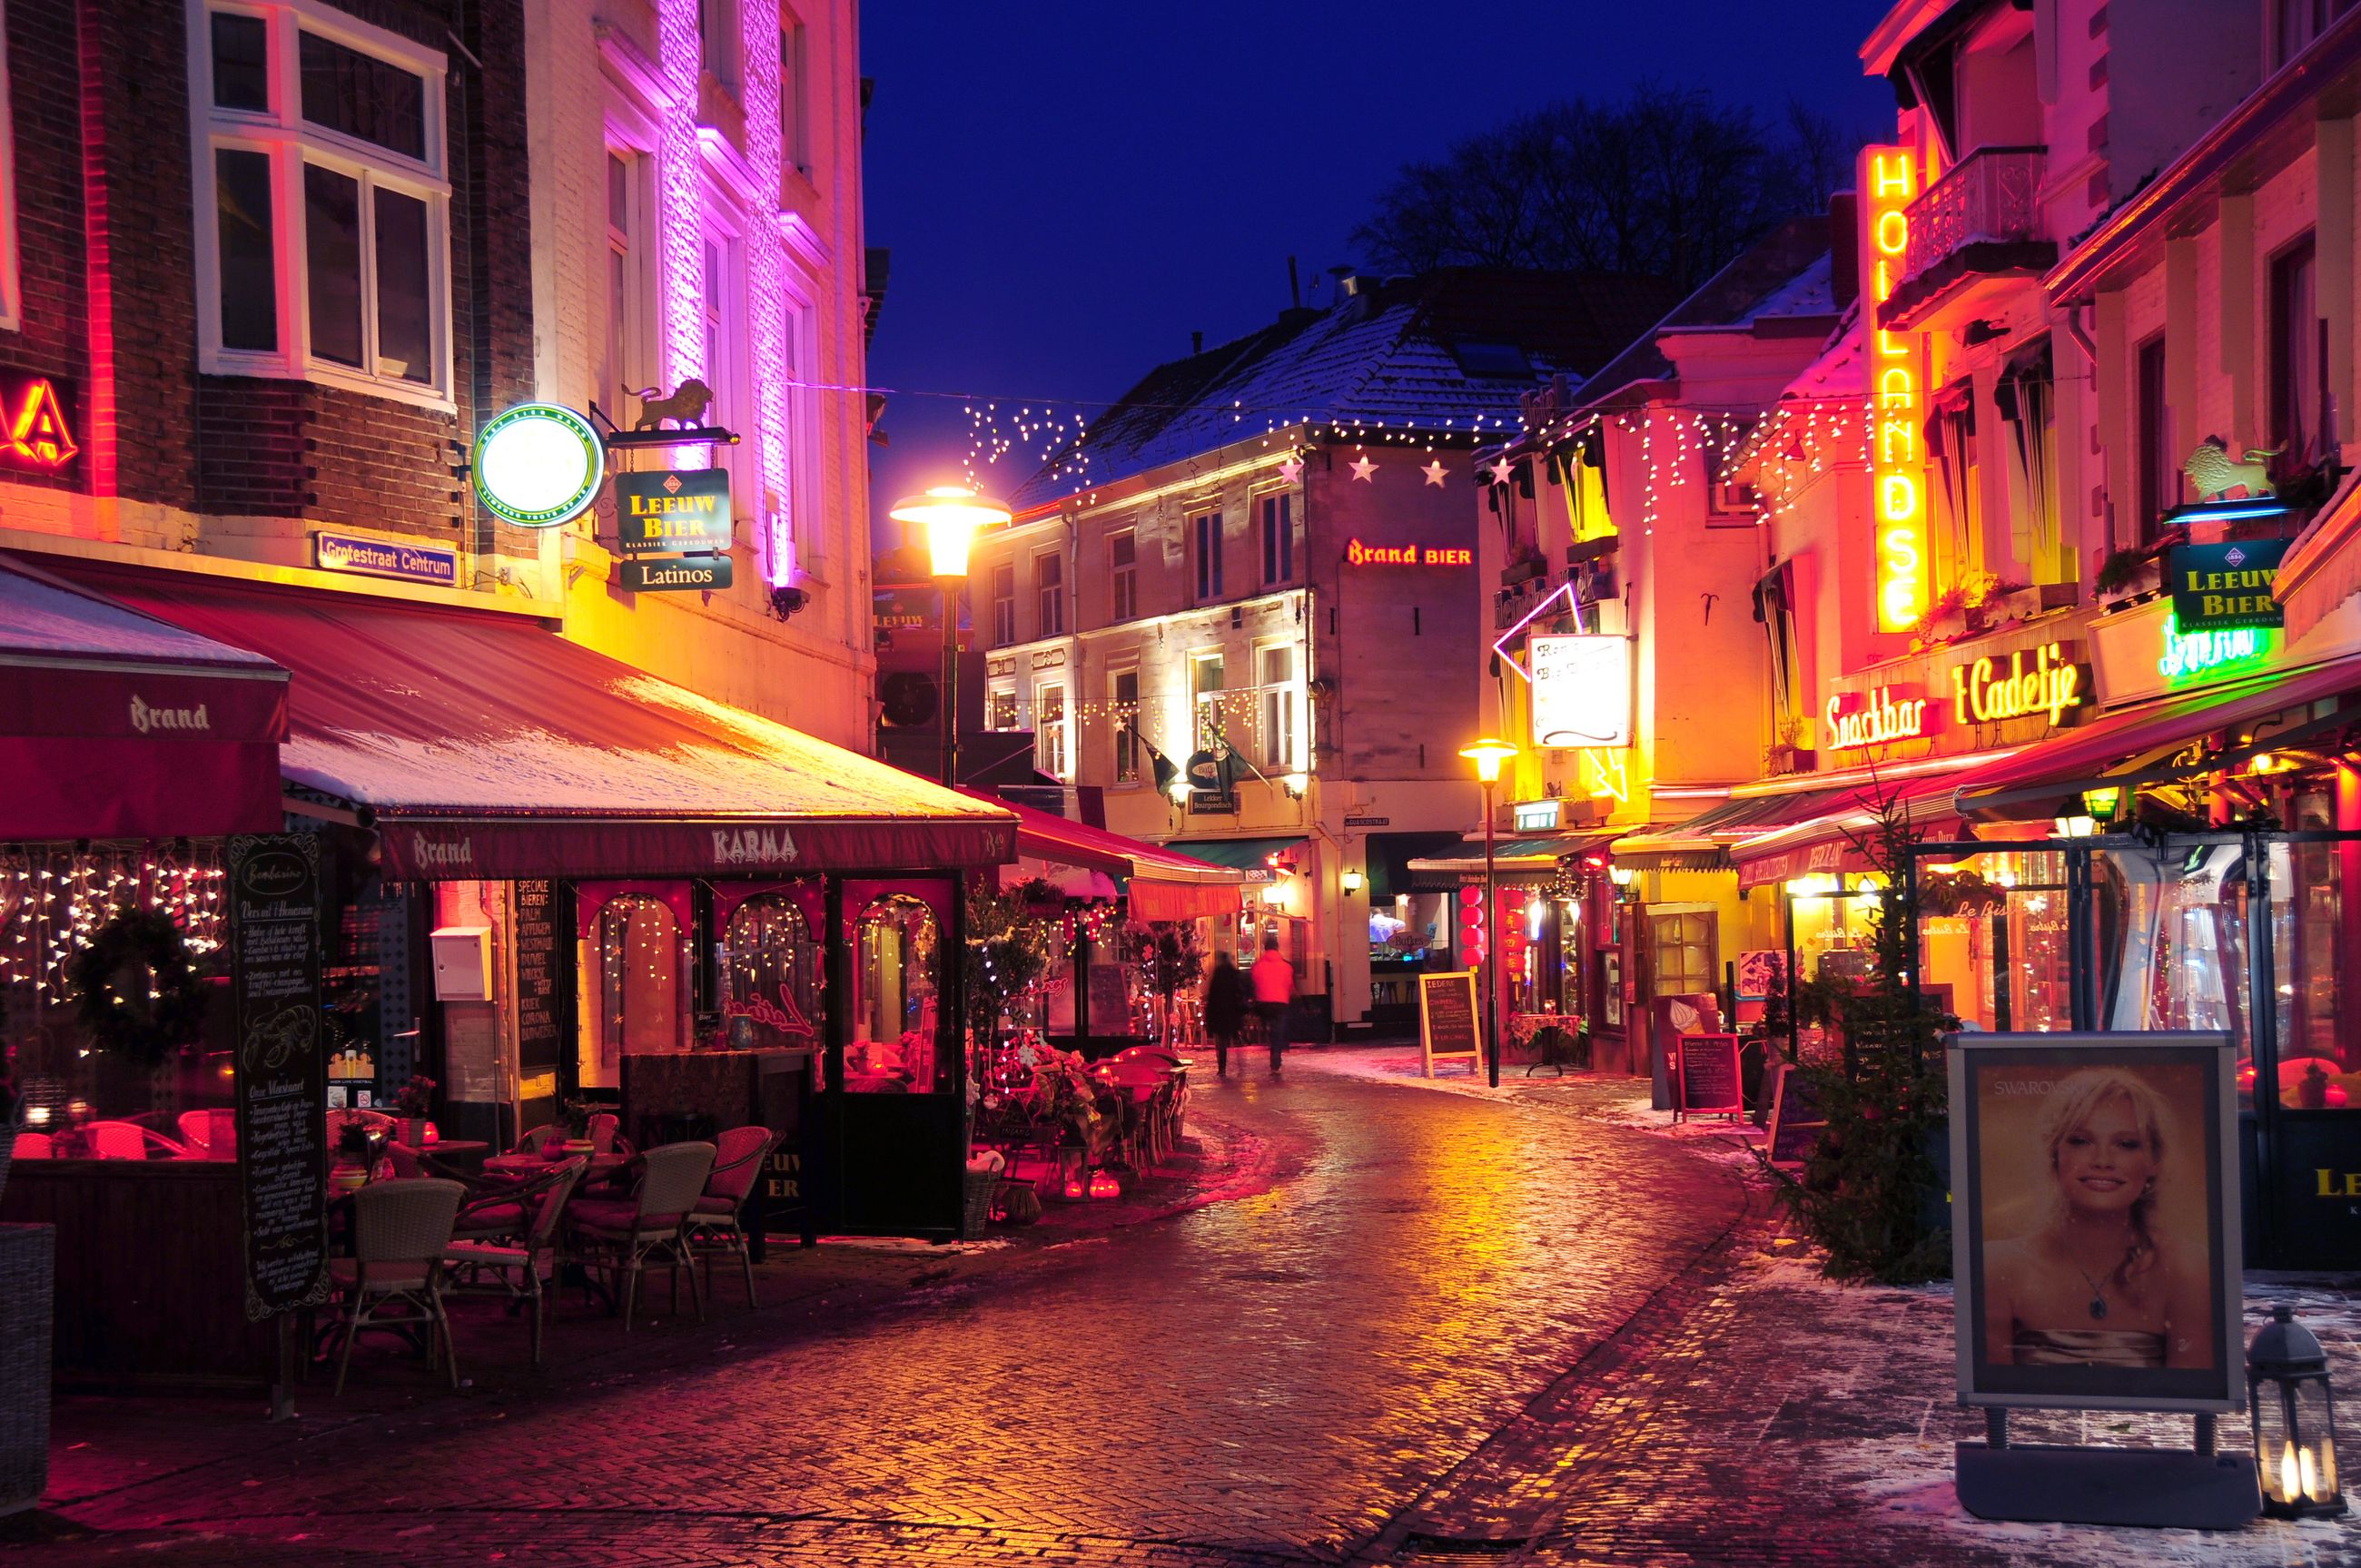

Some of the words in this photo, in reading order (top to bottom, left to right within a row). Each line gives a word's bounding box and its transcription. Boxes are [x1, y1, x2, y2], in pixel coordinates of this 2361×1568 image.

[630, 494, 716, 516] LEEUW
[643, 517, 707, 538] BIER
[326, 540, 398, 568] Grotestraat
[400, 552, 451, 576] Centrum
[1348, 537, 1418, 566] Brand
[1424, 548, 1472, 565] BIER
[641, 565, 714, 586] Latinos
[2187, 568, 2279, 592] LEEUW
[2201, 595, 2276, 616] BIER
[2182, 620, 2229, 628] KLASSIEK
[2235, 616, 2283, 626] GEBROUW
[1970, 641, 2082, 727] Cadetje
[131, 694, 211, 734] Brand
[1826, 685, 1927, 751] Snackbar
[414, 830, 473, 871] Brand
[711, 826, 799, 864] KARMA
[519, 880, 549, 893] SPECIALE
[521, 893, 548, 907] BIEREN:
[1953, 901, 1977, 917] Le
[1395, 935, 1425, 947] Bufkes
[521, 952, 547, 966] DUVEL
[521, 1011, 552, 1026] CORONA
[698, 1013, 712, 1021] Bier
[2314, 1169, 2361, 1197] LE
